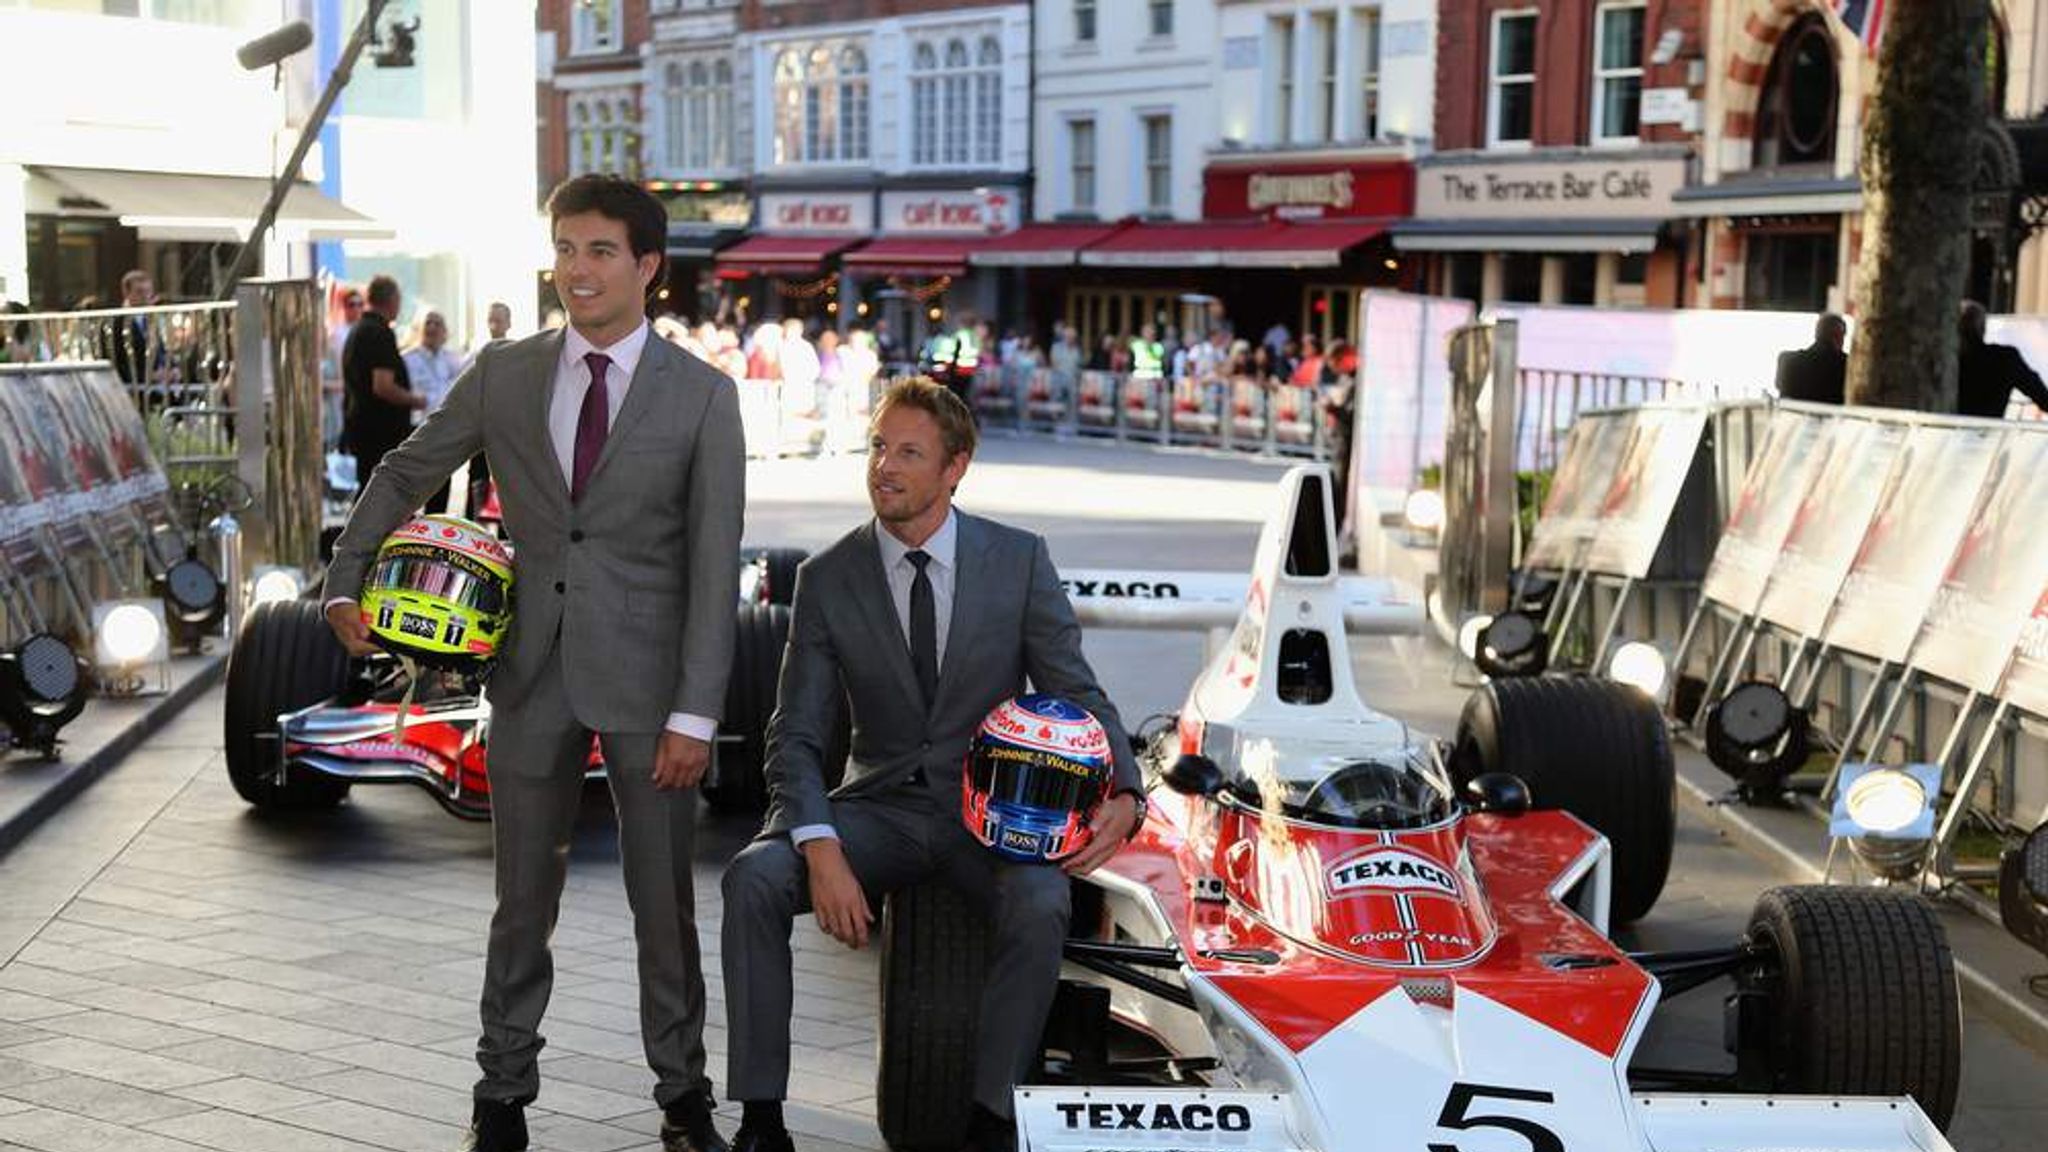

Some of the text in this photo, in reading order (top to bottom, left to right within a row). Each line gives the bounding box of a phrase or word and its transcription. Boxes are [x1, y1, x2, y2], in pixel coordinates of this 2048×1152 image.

[1443, 169, 1651, 200] The Terrace Bar Café
[988, 747, 1090, 778] JOHNNIE WALKER
[1004, 831, 1039, 849] BOSS
[1335, 860, 1454, 890] TEXACO
[1056, 1103, 1252, 1132] TEXACO
[1427, 1082, 1566, 1152] 5
